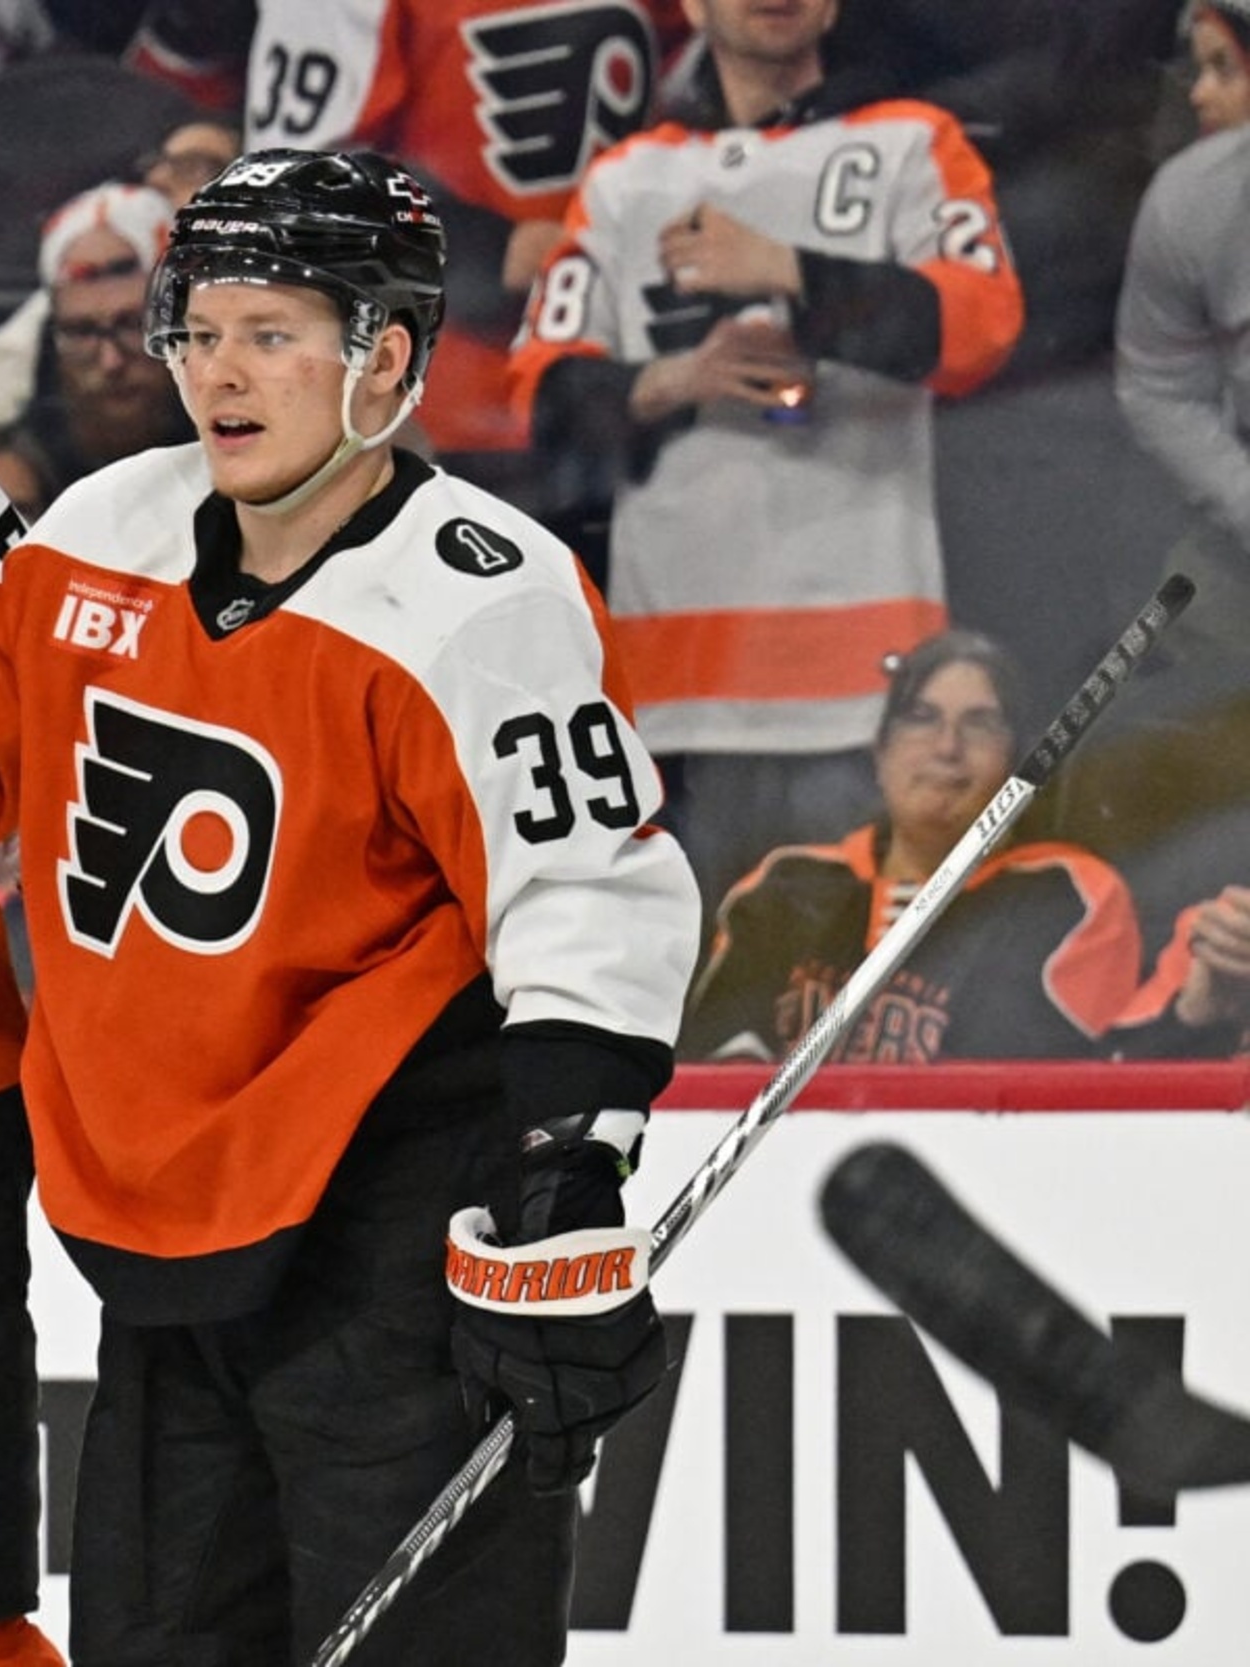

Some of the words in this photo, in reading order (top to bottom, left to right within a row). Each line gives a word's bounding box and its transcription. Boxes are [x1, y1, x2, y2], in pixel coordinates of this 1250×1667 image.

[253, 44, 338, 135] 39
[813, 141, 882, 237] C
[932, 201, 998, 275] 2
[533, 254, 591, 344] 8
[455, 523, 508, 570] 1
[52, 594, 147, 661] IBX
[492, 701, 641, 845] 39
